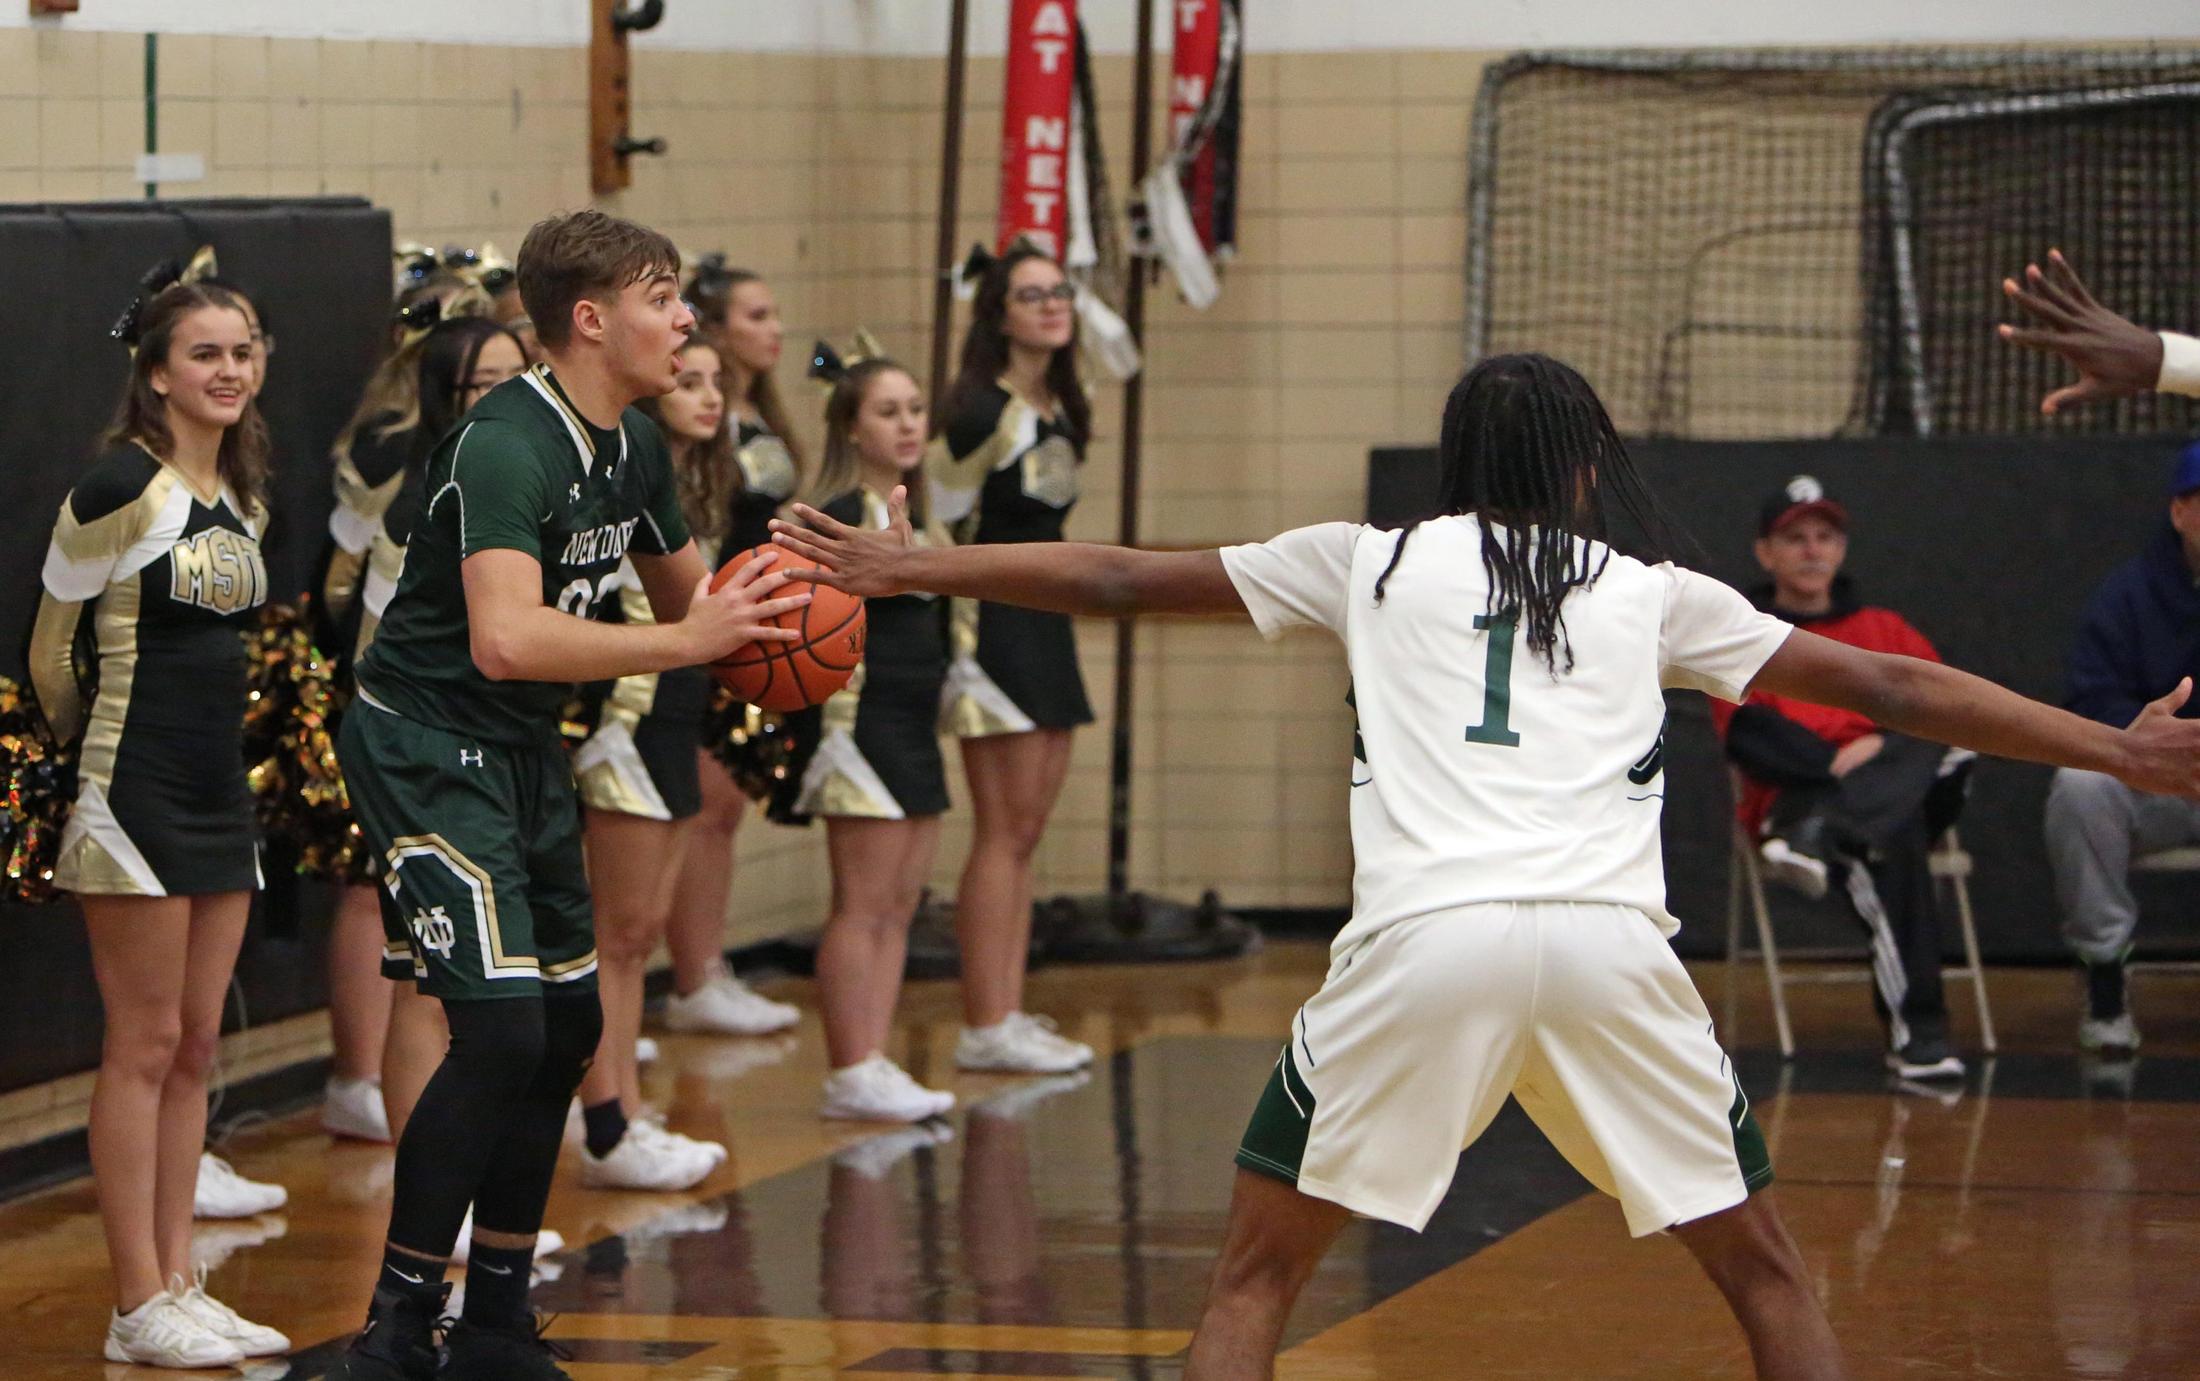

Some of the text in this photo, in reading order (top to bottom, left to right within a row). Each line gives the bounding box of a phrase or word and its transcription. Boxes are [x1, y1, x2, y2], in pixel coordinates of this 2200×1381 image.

[560, 516, 639, 566] NEW DOV
[1465, 610, 1520, 748] 1
